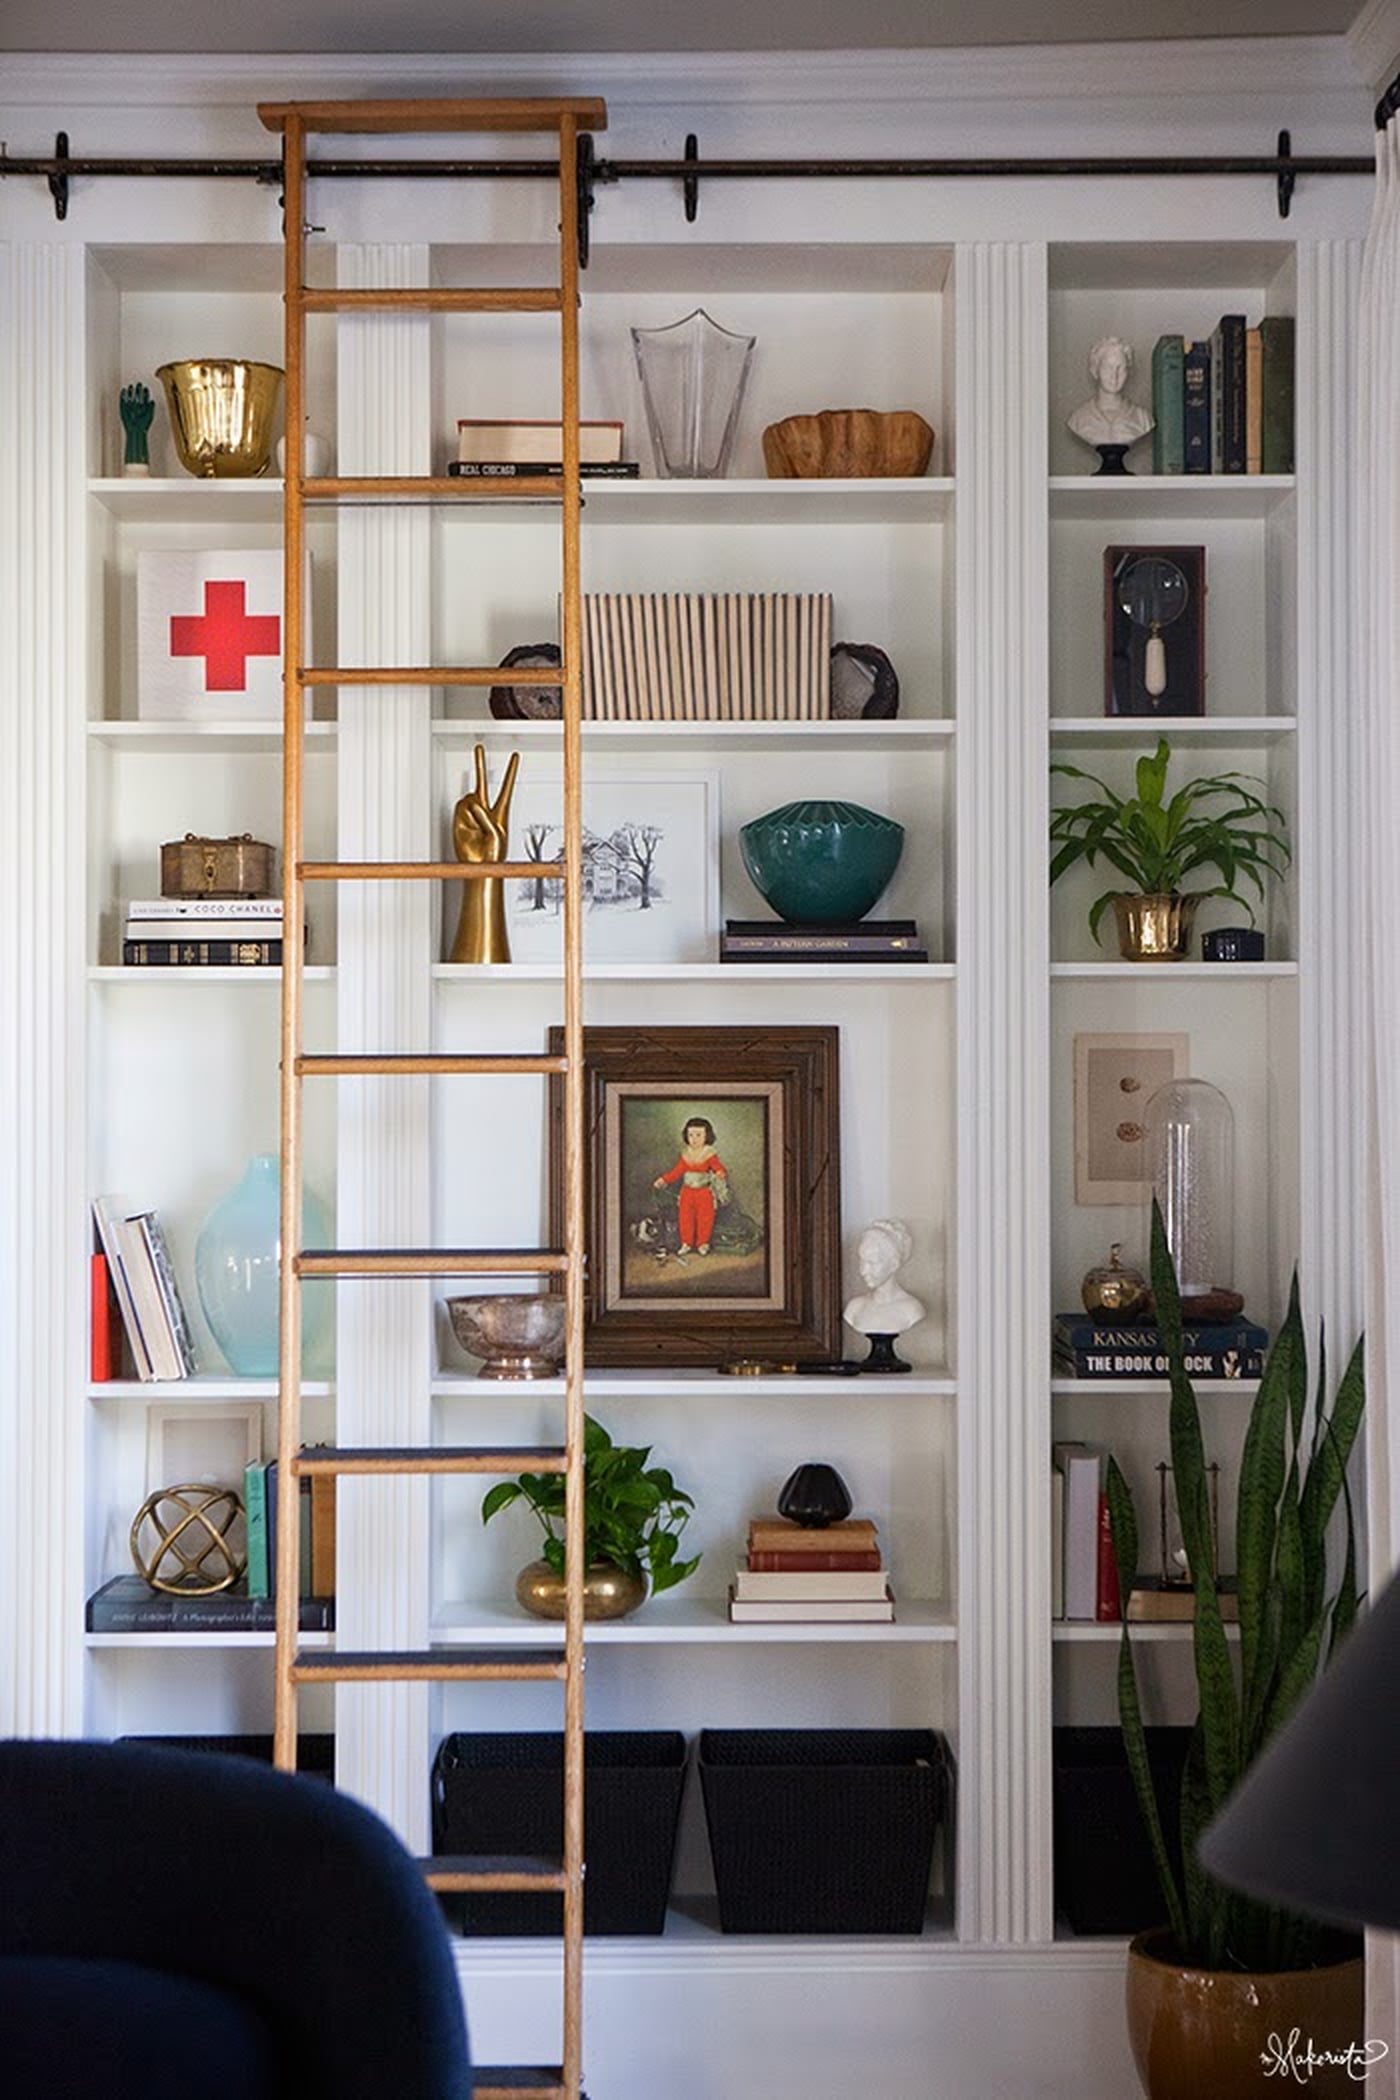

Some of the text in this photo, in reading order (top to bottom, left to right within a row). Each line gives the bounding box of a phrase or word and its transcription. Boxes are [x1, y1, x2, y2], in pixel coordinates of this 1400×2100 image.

[459, 464, 516, 476] REAL CHICAGO
[194, 904, 272, 914] COCO CHANEL
[1093, 1332, 1157, 1347] KANSAS
[1086, 1355, 1112, 1372] THE
[1114, 1355, 1153, 1372] BOOK
[1181, 1355, 1213, 1372] OCK
